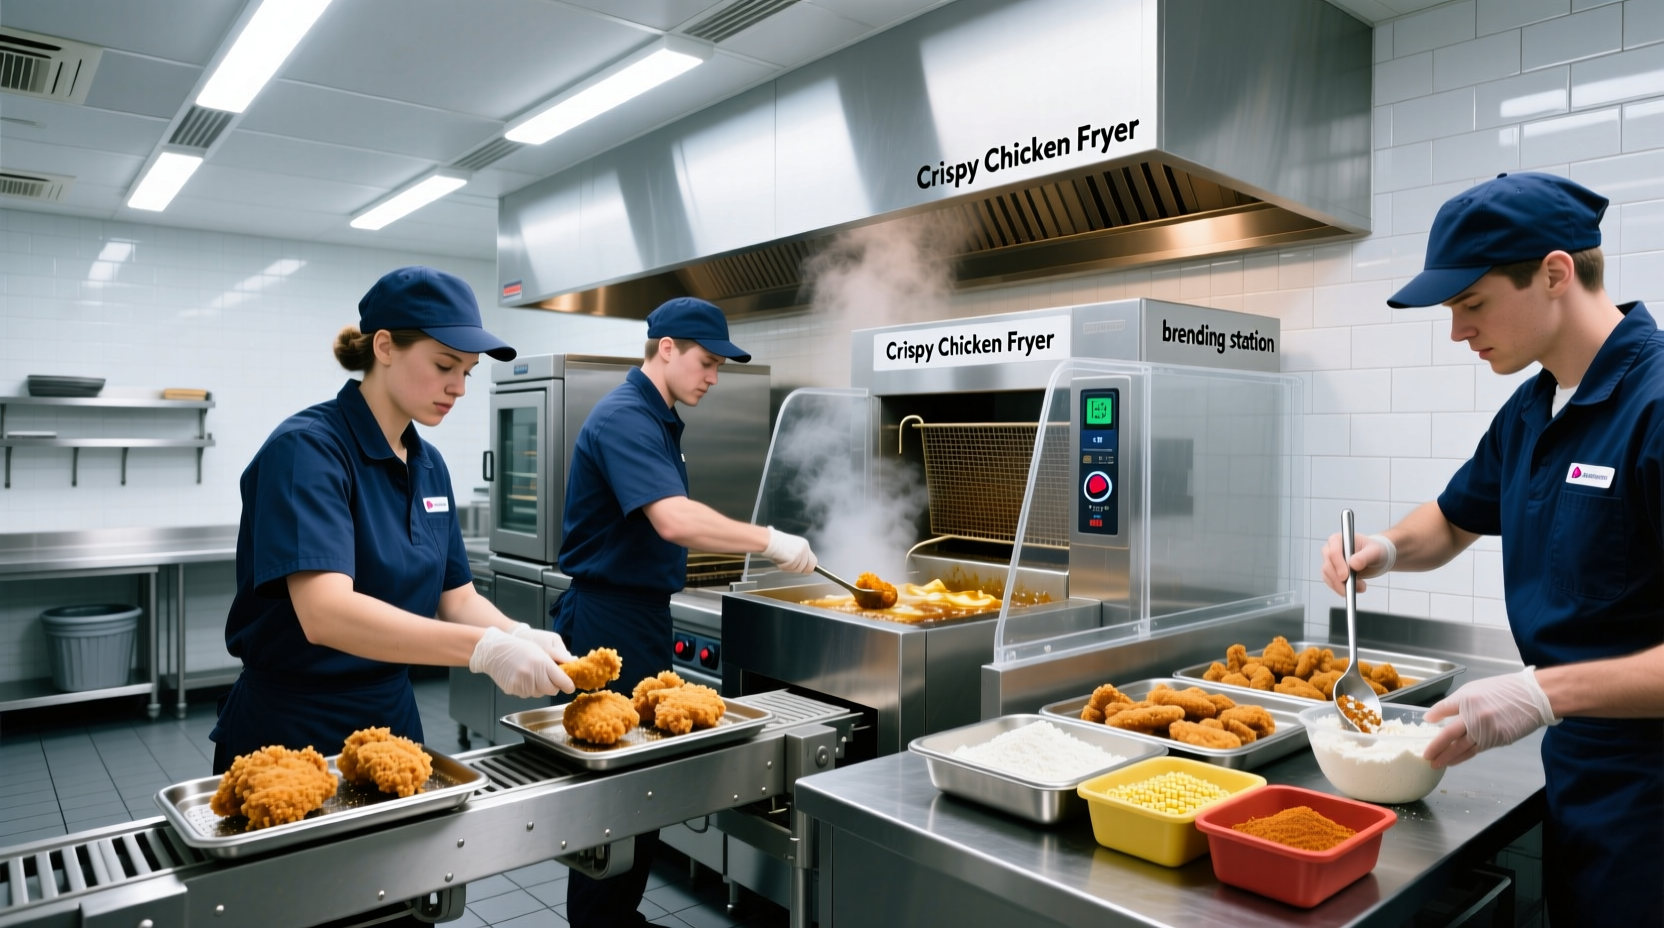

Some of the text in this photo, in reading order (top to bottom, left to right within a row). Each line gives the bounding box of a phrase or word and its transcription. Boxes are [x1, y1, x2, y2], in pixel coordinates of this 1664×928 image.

[917, 119, 1140, 189] Crispy Chicken Fryer
[886, 331, 1055, 364] Crispy Chicken Fryer
[1162, 319, 1275, 354] brending station
